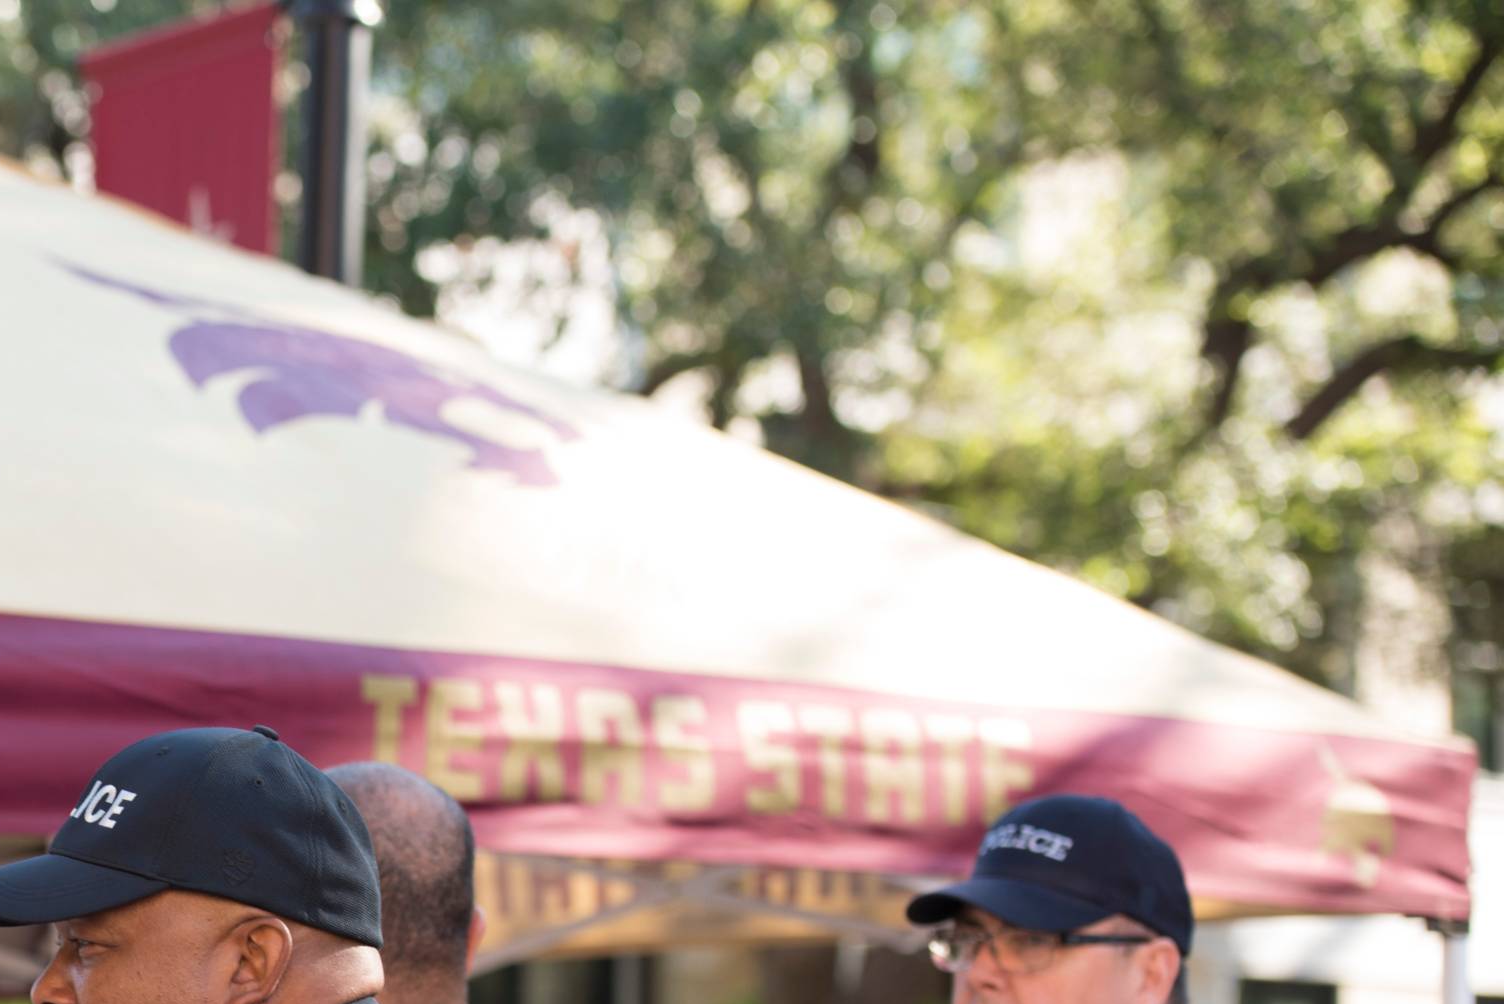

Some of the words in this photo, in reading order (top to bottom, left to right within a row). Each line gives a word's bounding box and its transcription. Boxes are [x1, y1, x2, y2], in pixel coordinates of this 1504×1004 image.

[360, 673, 715, 813] TEXAS
[735, 701, 1035, 826] STATE
[69, 779, 138, 829] ICE
